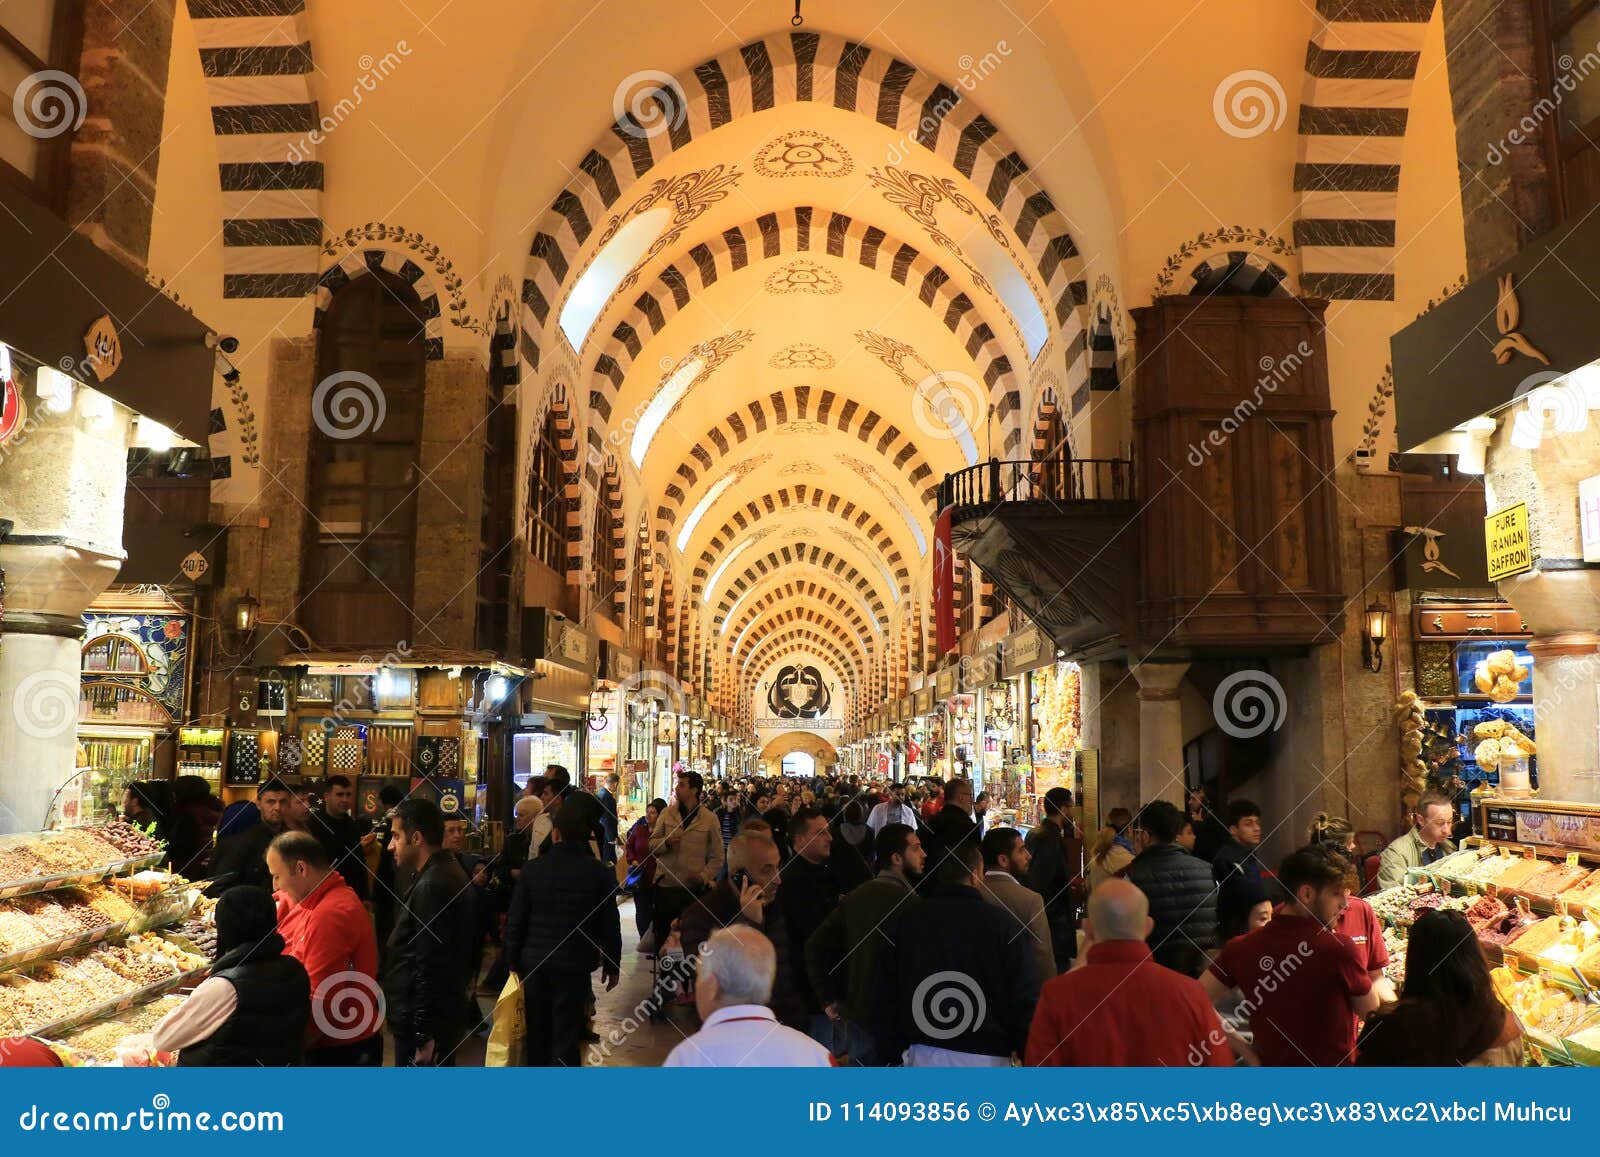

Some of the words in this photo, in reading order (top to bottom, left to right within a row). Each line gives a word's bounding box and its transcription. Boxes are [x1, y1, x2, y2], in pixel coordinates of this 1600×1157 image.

[1495, 512, 1517, 533] PURE
[1491, 530, 1524, 554] IRANIAN
[1491, 549, 1527, 573] SAFFRON
